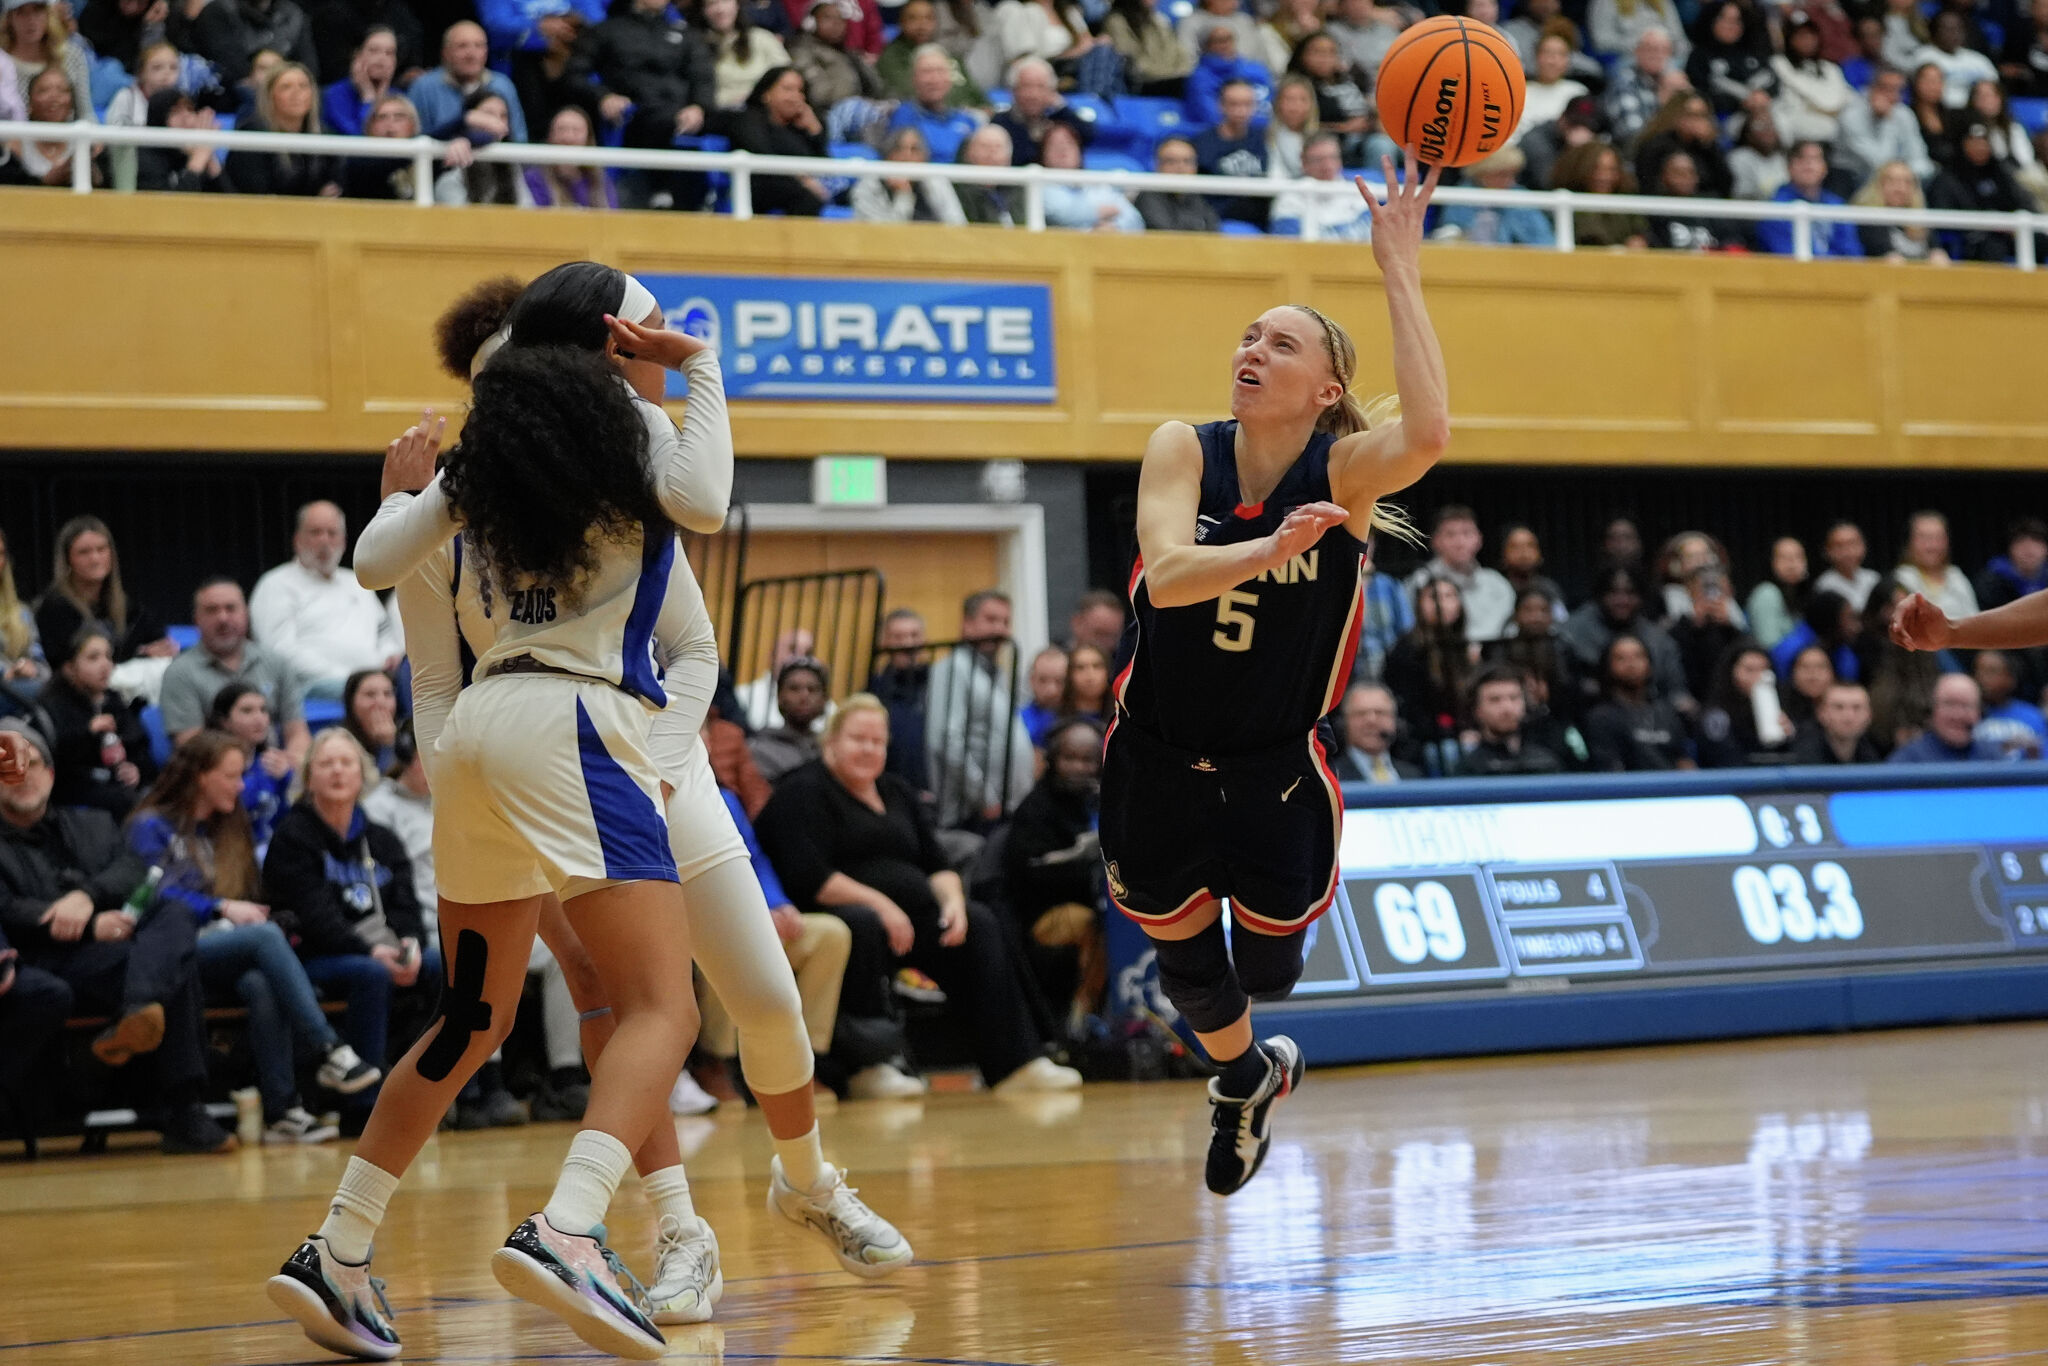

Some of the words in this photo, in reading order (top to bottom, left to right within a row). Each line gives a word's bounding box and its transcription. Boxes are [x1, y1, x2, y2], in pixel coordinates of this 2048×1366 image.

[1420, 78, 1459, 161] Wilson
[734, 301, 1036, 354] PIRATE
[734, 353, 1037, 380] BASKETBALL
[510, 587, 557, 625] EADS
[1212, 589, 1260, 653] 5
[1497, 878, 1561, 904] FOULS
[1586, 872, 1606, 900] 4
[1732, 861, 1864, 944] 03.3
[1373, 880, 1467, 965] 69
[1513, 929, 1605, 959] TIMEOUTS
